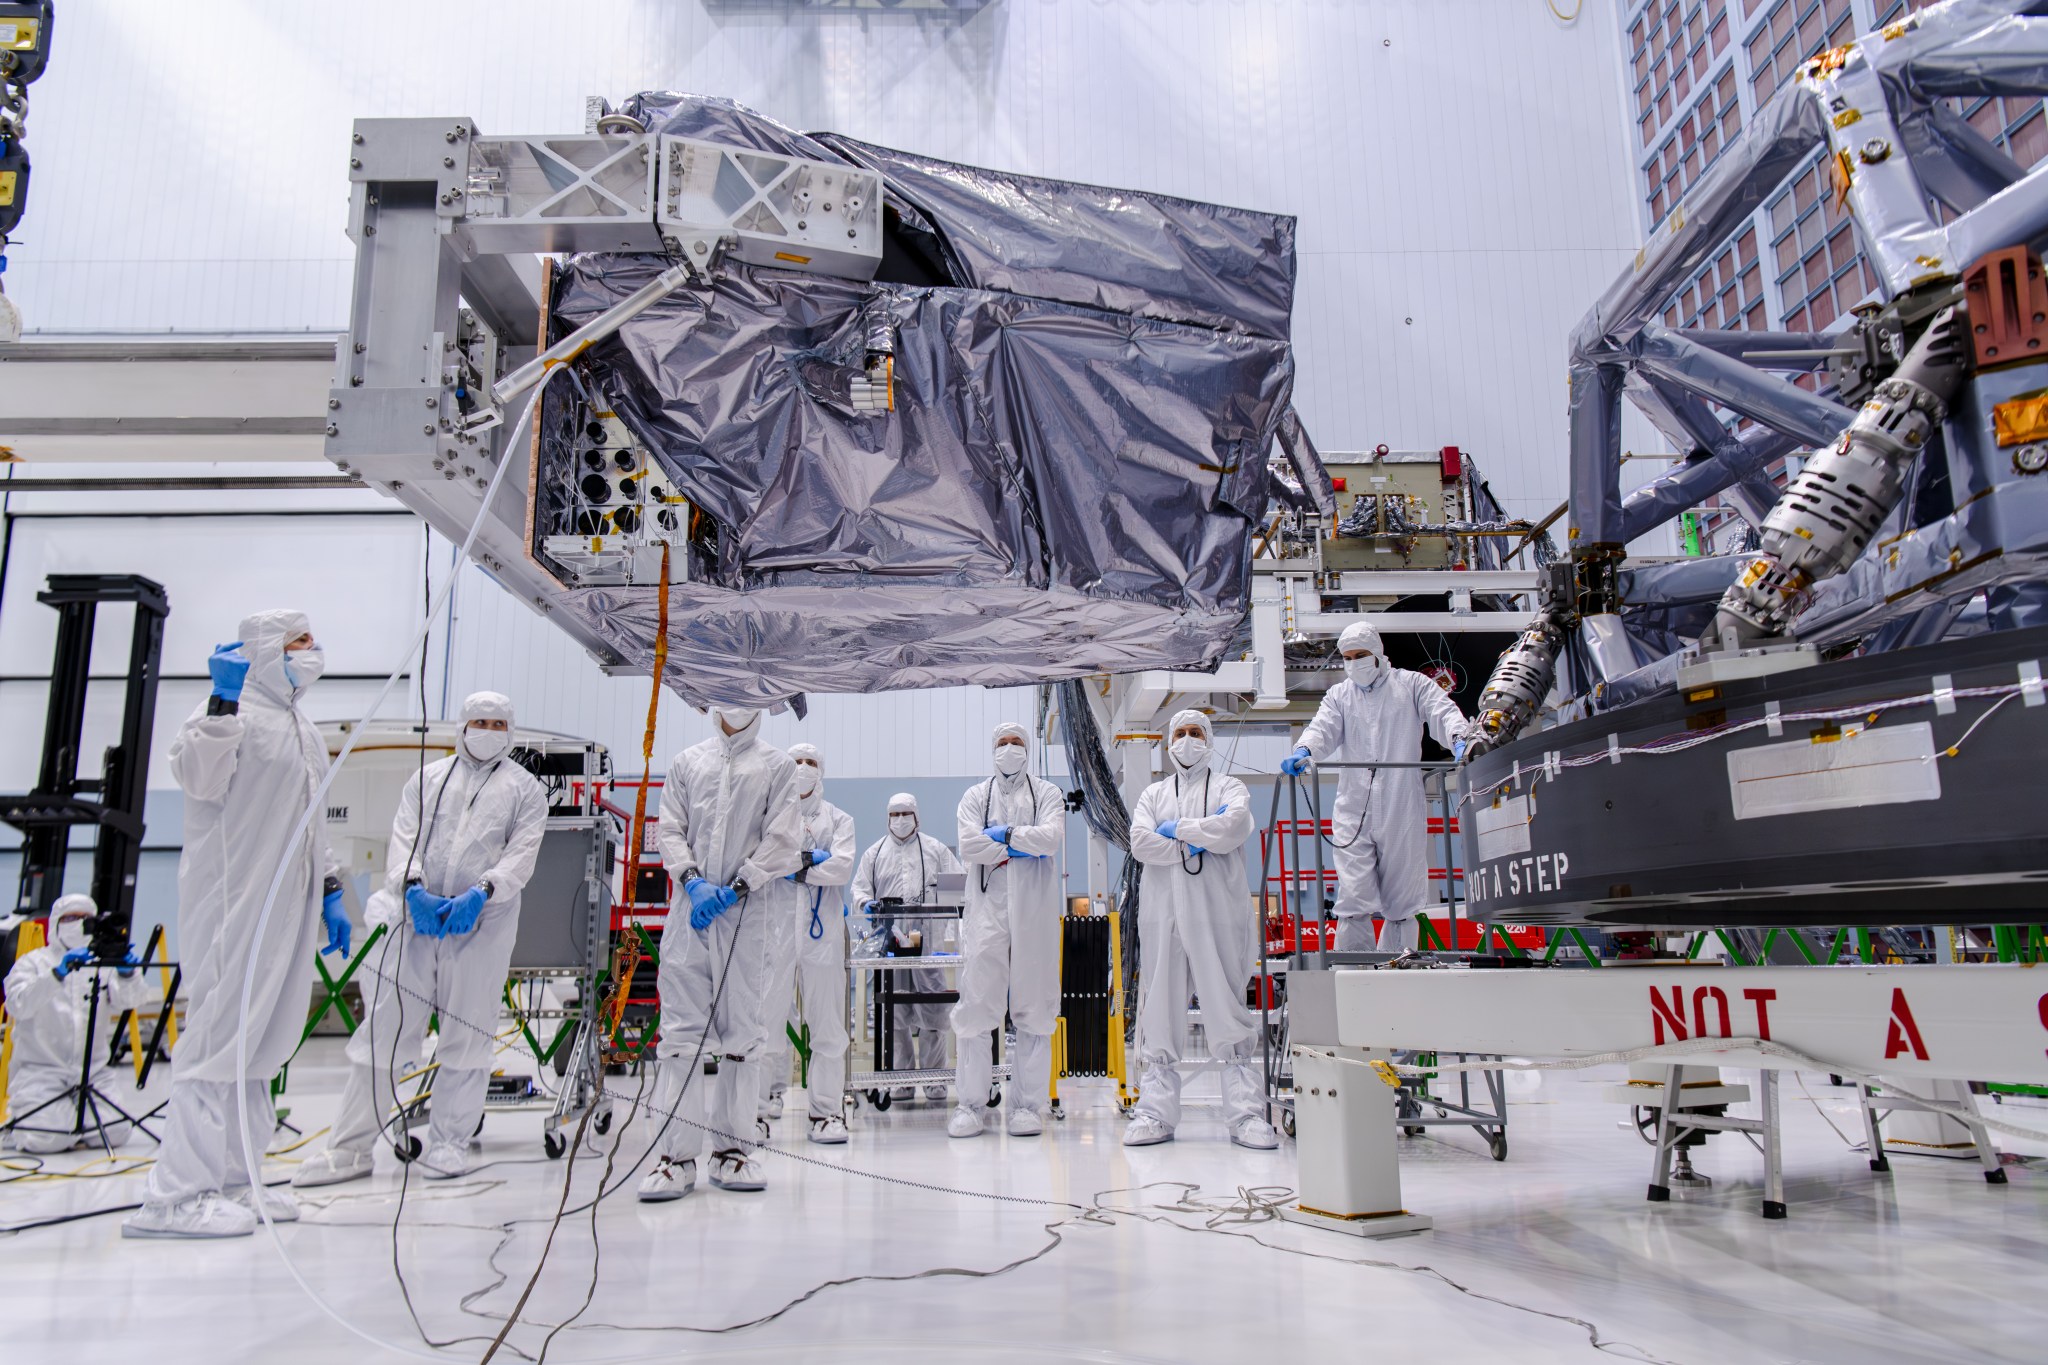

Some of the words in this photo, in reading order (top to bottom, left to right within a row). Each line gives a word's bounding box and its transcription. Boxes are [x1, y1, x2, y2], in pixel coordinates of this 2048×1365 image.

[1468, 867, 1487, 904] NOT
[1494, 864, 1503, 898] A
[1508, 852, 1569, 896] STEP
[1649, 985, 1777, 1047] NOT
[1884, 987, 1930, 1061] A
